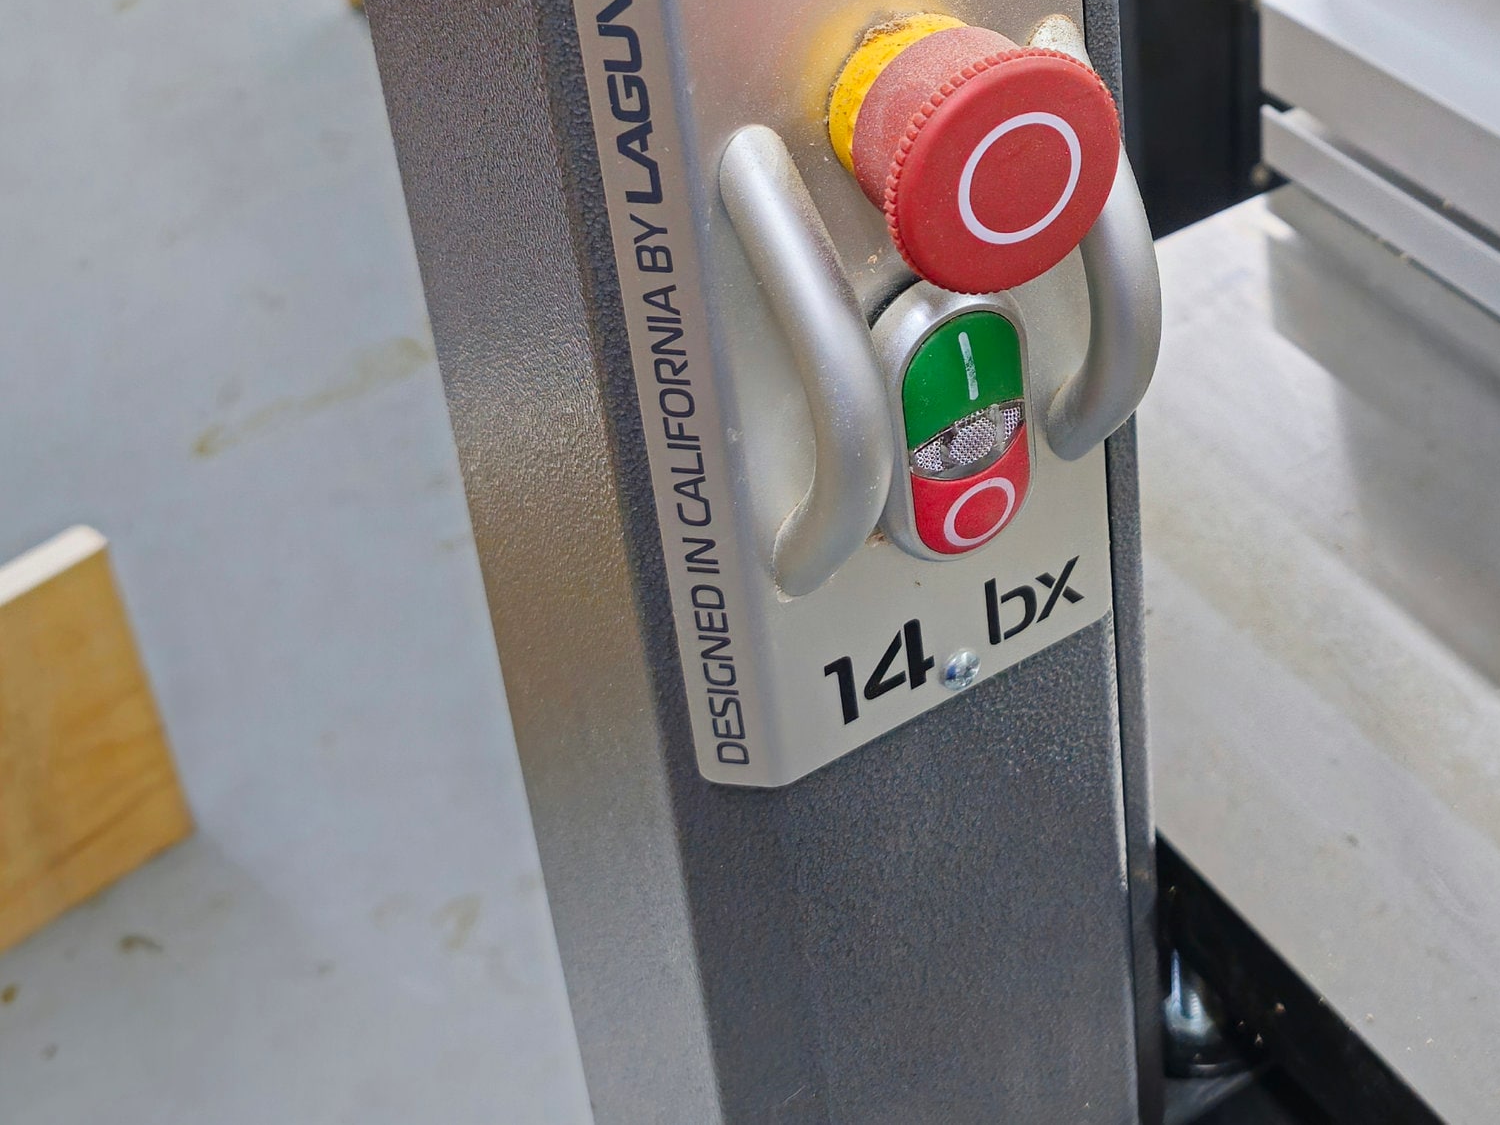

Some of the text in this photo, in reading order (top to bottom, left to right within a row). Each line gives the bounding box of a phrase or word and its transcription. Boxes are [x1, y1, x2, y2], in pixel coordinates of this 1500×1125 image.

[629, 212, 674, 274] BY
[642, 283, 712, 527] CALIFORNIA
[681, 536, 721, 574] IN
[823, 554, 1086, 725] 14 bx
[690, 583, 751, 765] DESIGNED
